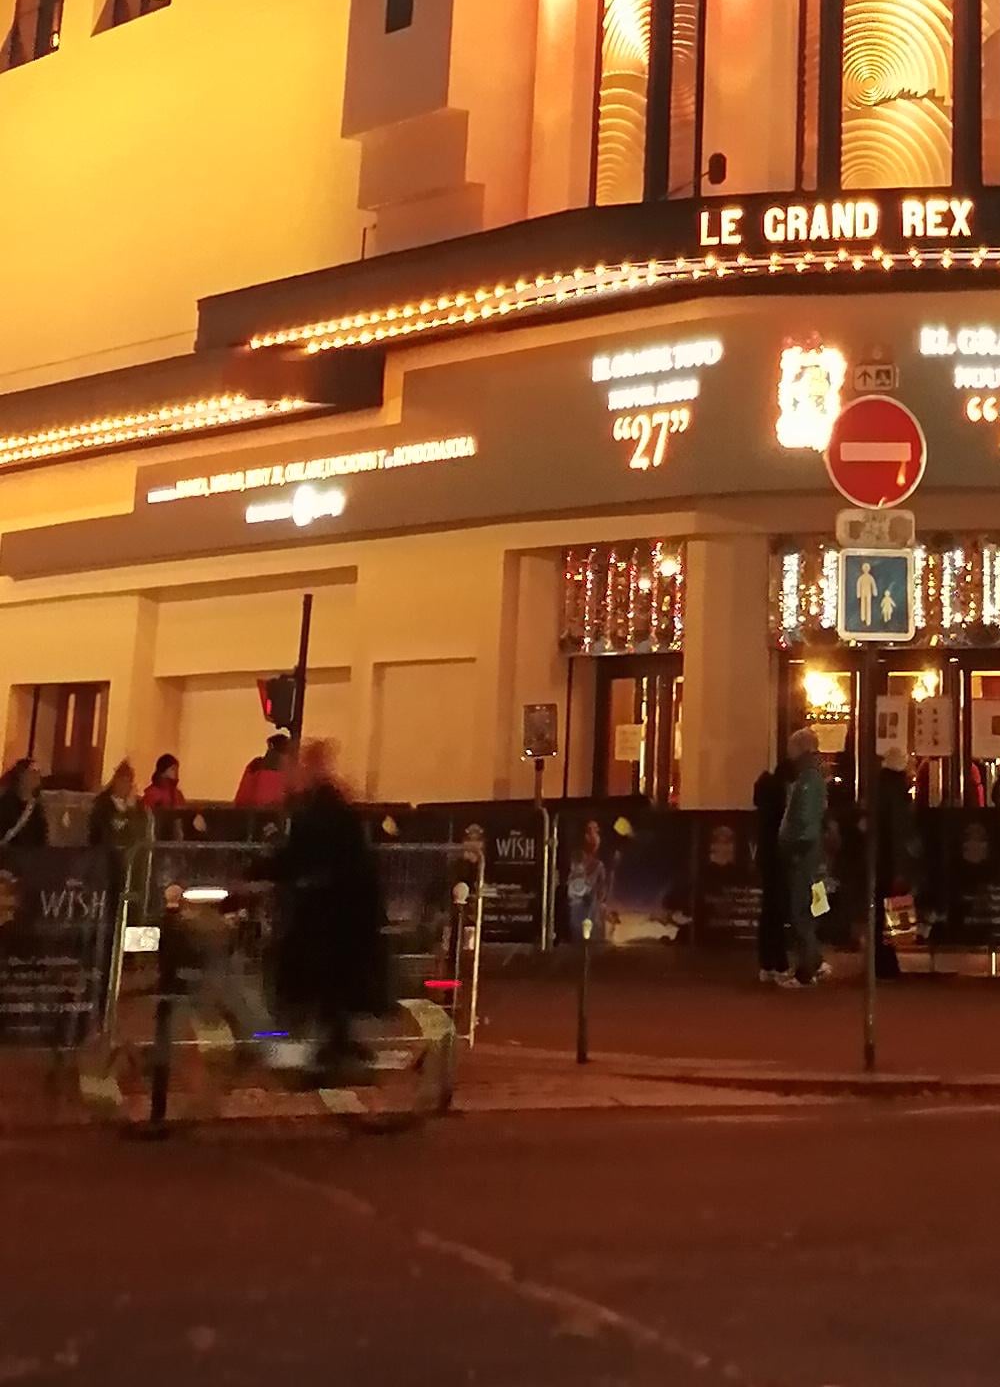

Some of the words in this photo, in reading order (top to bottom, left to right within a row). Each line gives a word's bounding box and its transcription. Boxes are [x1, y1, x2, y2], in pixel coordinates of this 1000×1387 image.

[700, 208, 743, 246] LE
[763, 201, 879, 242] GRAND
[901, 199, 973, 237] REX
[495, 837, 535, 859] WISH
[40, 888, 107, 919] WISH
